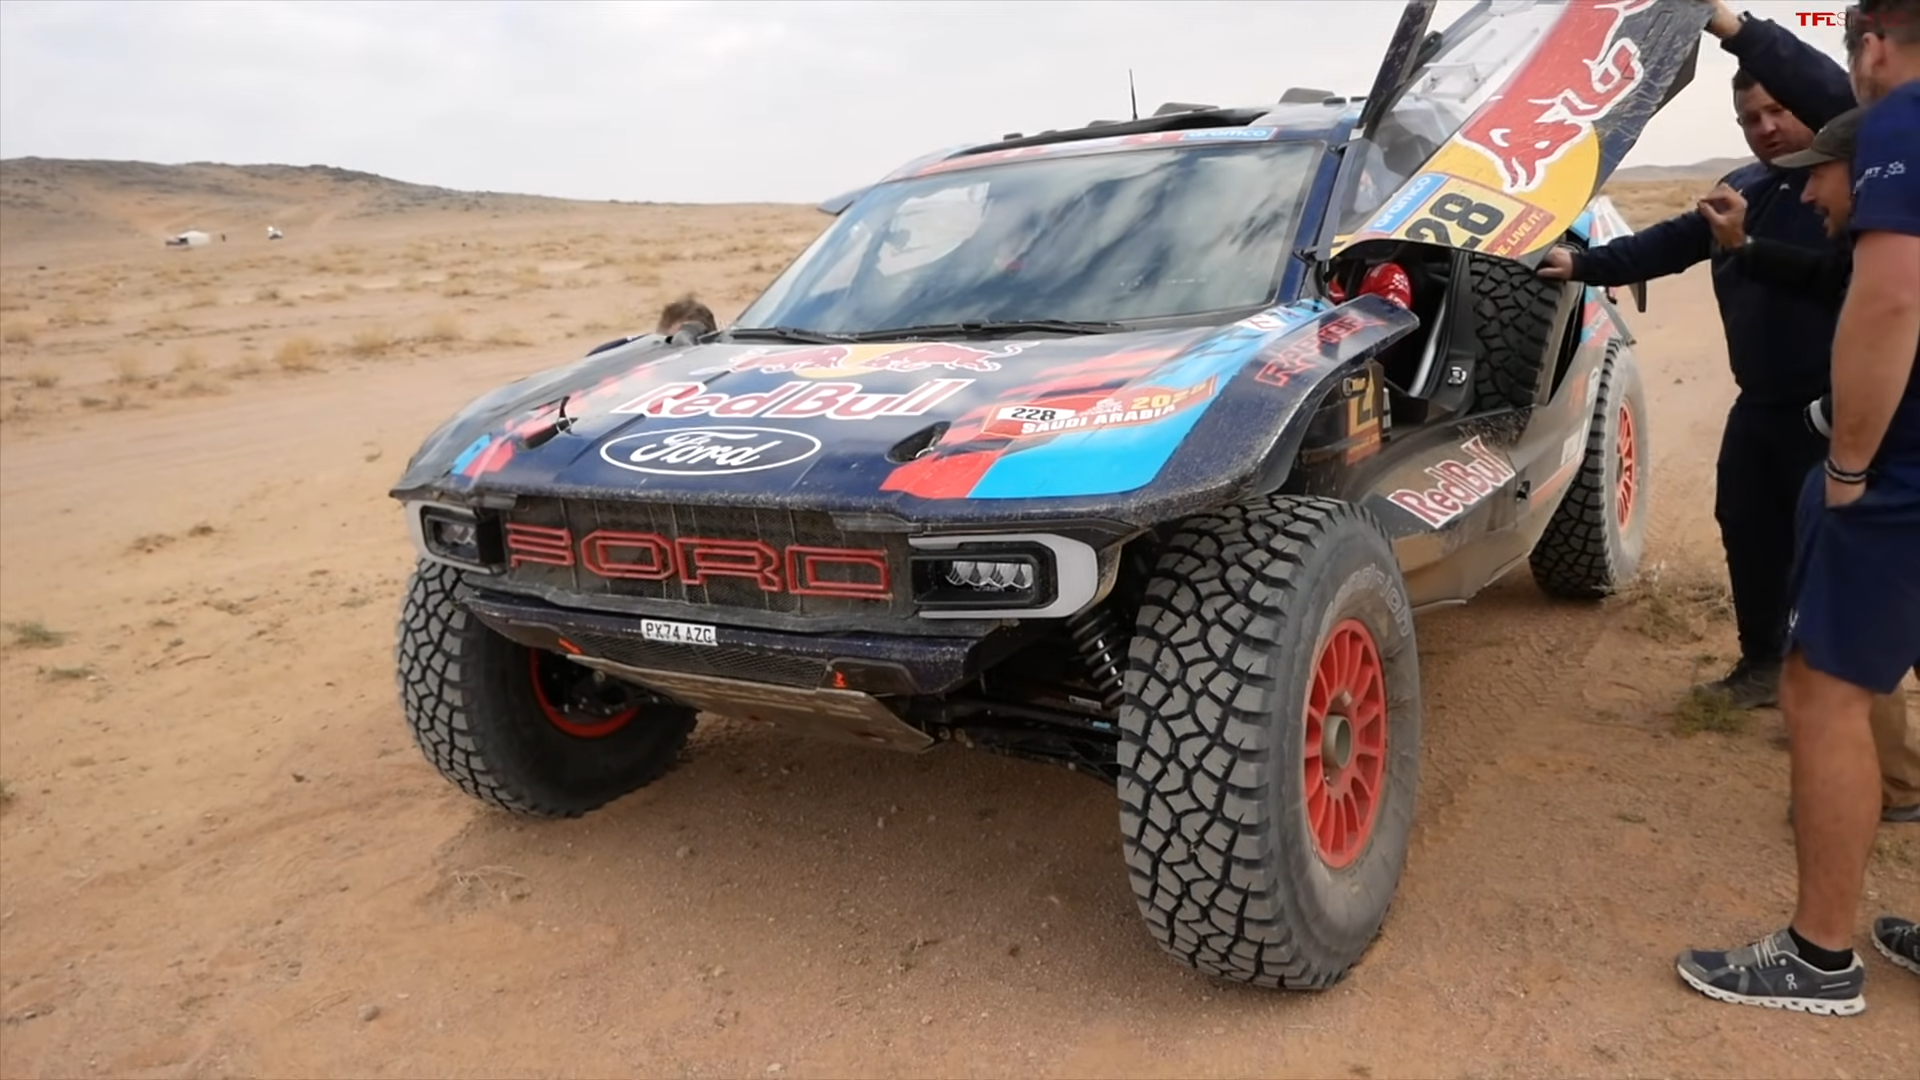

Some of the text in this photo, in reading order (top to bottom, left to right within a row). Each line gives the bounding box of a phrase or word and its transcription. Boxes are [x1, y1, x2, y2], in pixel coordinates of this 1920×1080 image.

[1374, 175, 1432, 229] aramco
[1506, 221, 1533, 246] LIVE
[1011, 407, 1057, 422] 228
[1020, 416, 1088, 435] SAUDI
[1093, 403, 1176, 426] ARABIA
[629, 430, 783, 467] Ford
[505, 522, 895, 601] FORD
[645, 621, 681, 641] PX74
